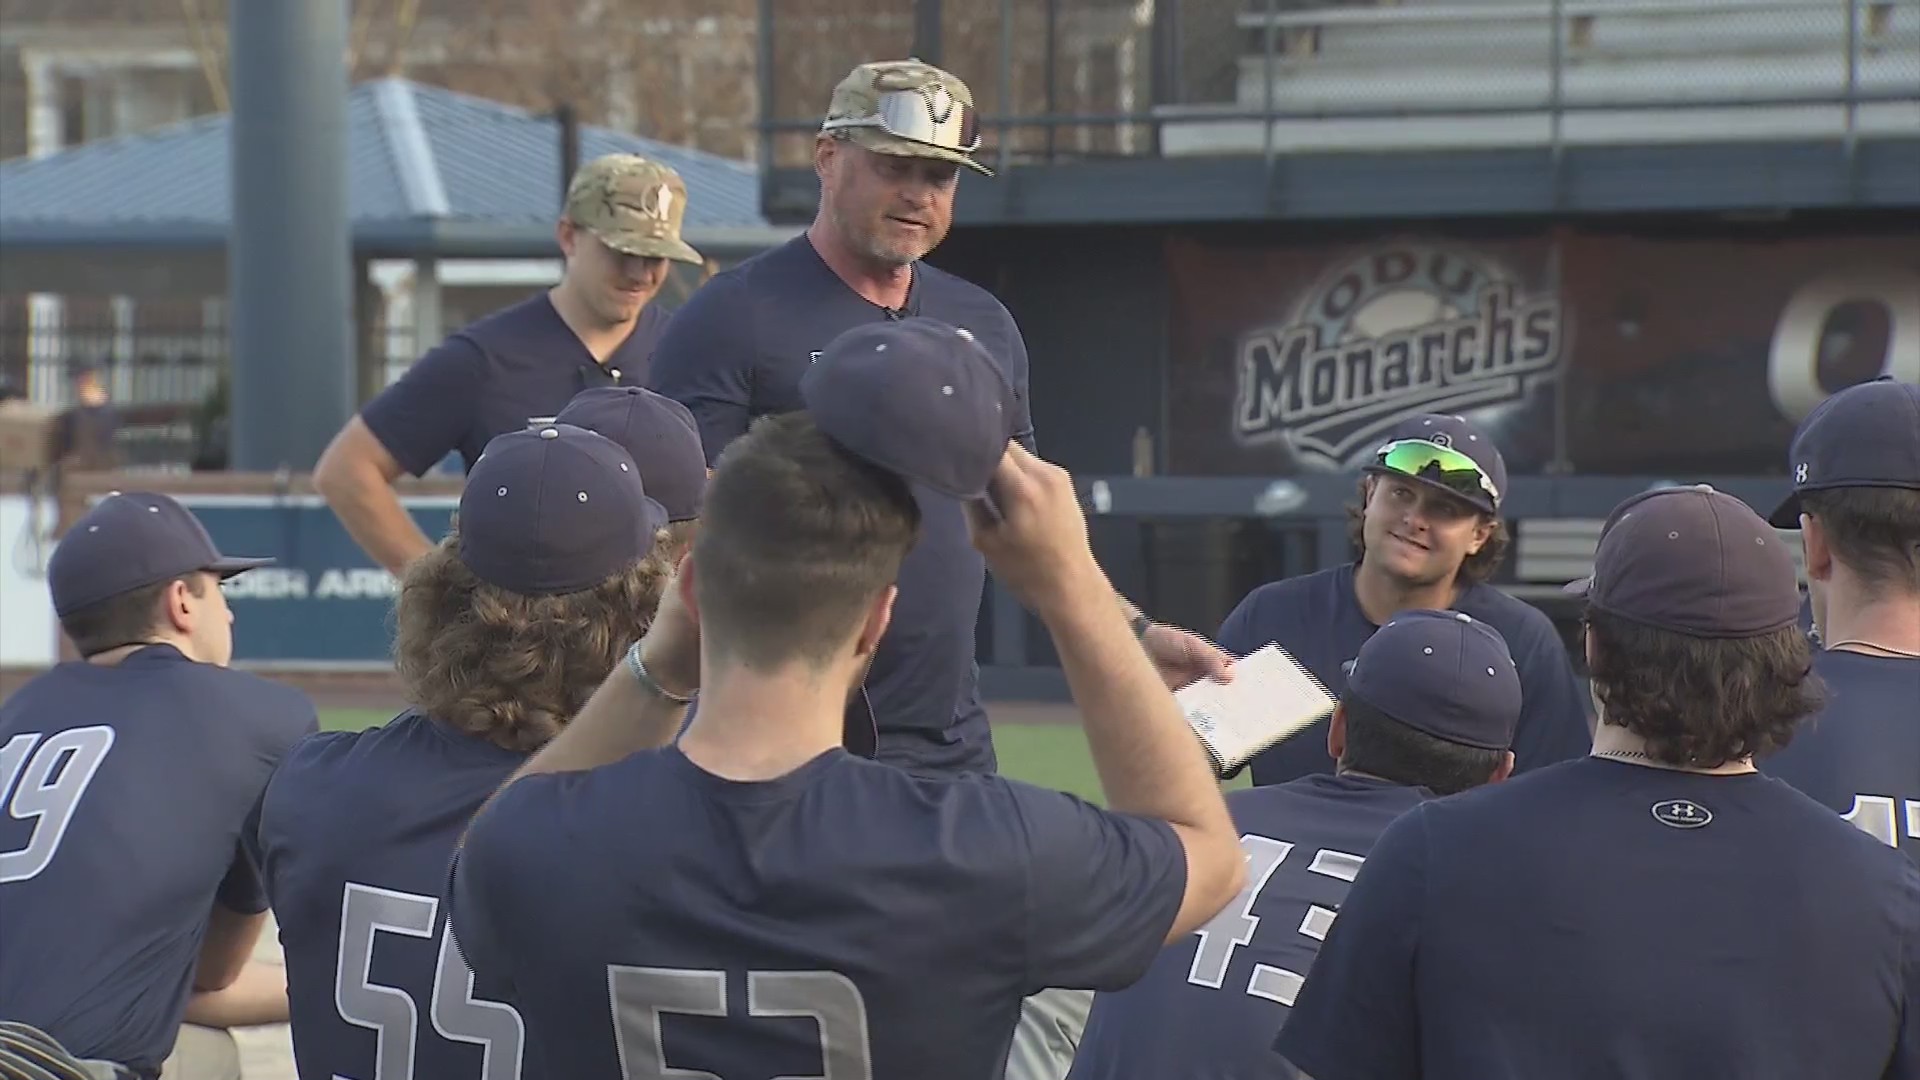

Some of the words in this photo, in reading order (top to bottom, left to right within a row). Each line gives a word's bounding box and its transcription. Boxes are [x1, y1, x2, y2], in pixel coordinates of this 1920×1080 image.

[1240, 283, 1558, 430] Monarchs
[1321, 249, 1475, 321] ODU
[334, 881, 526, 1080] 55
